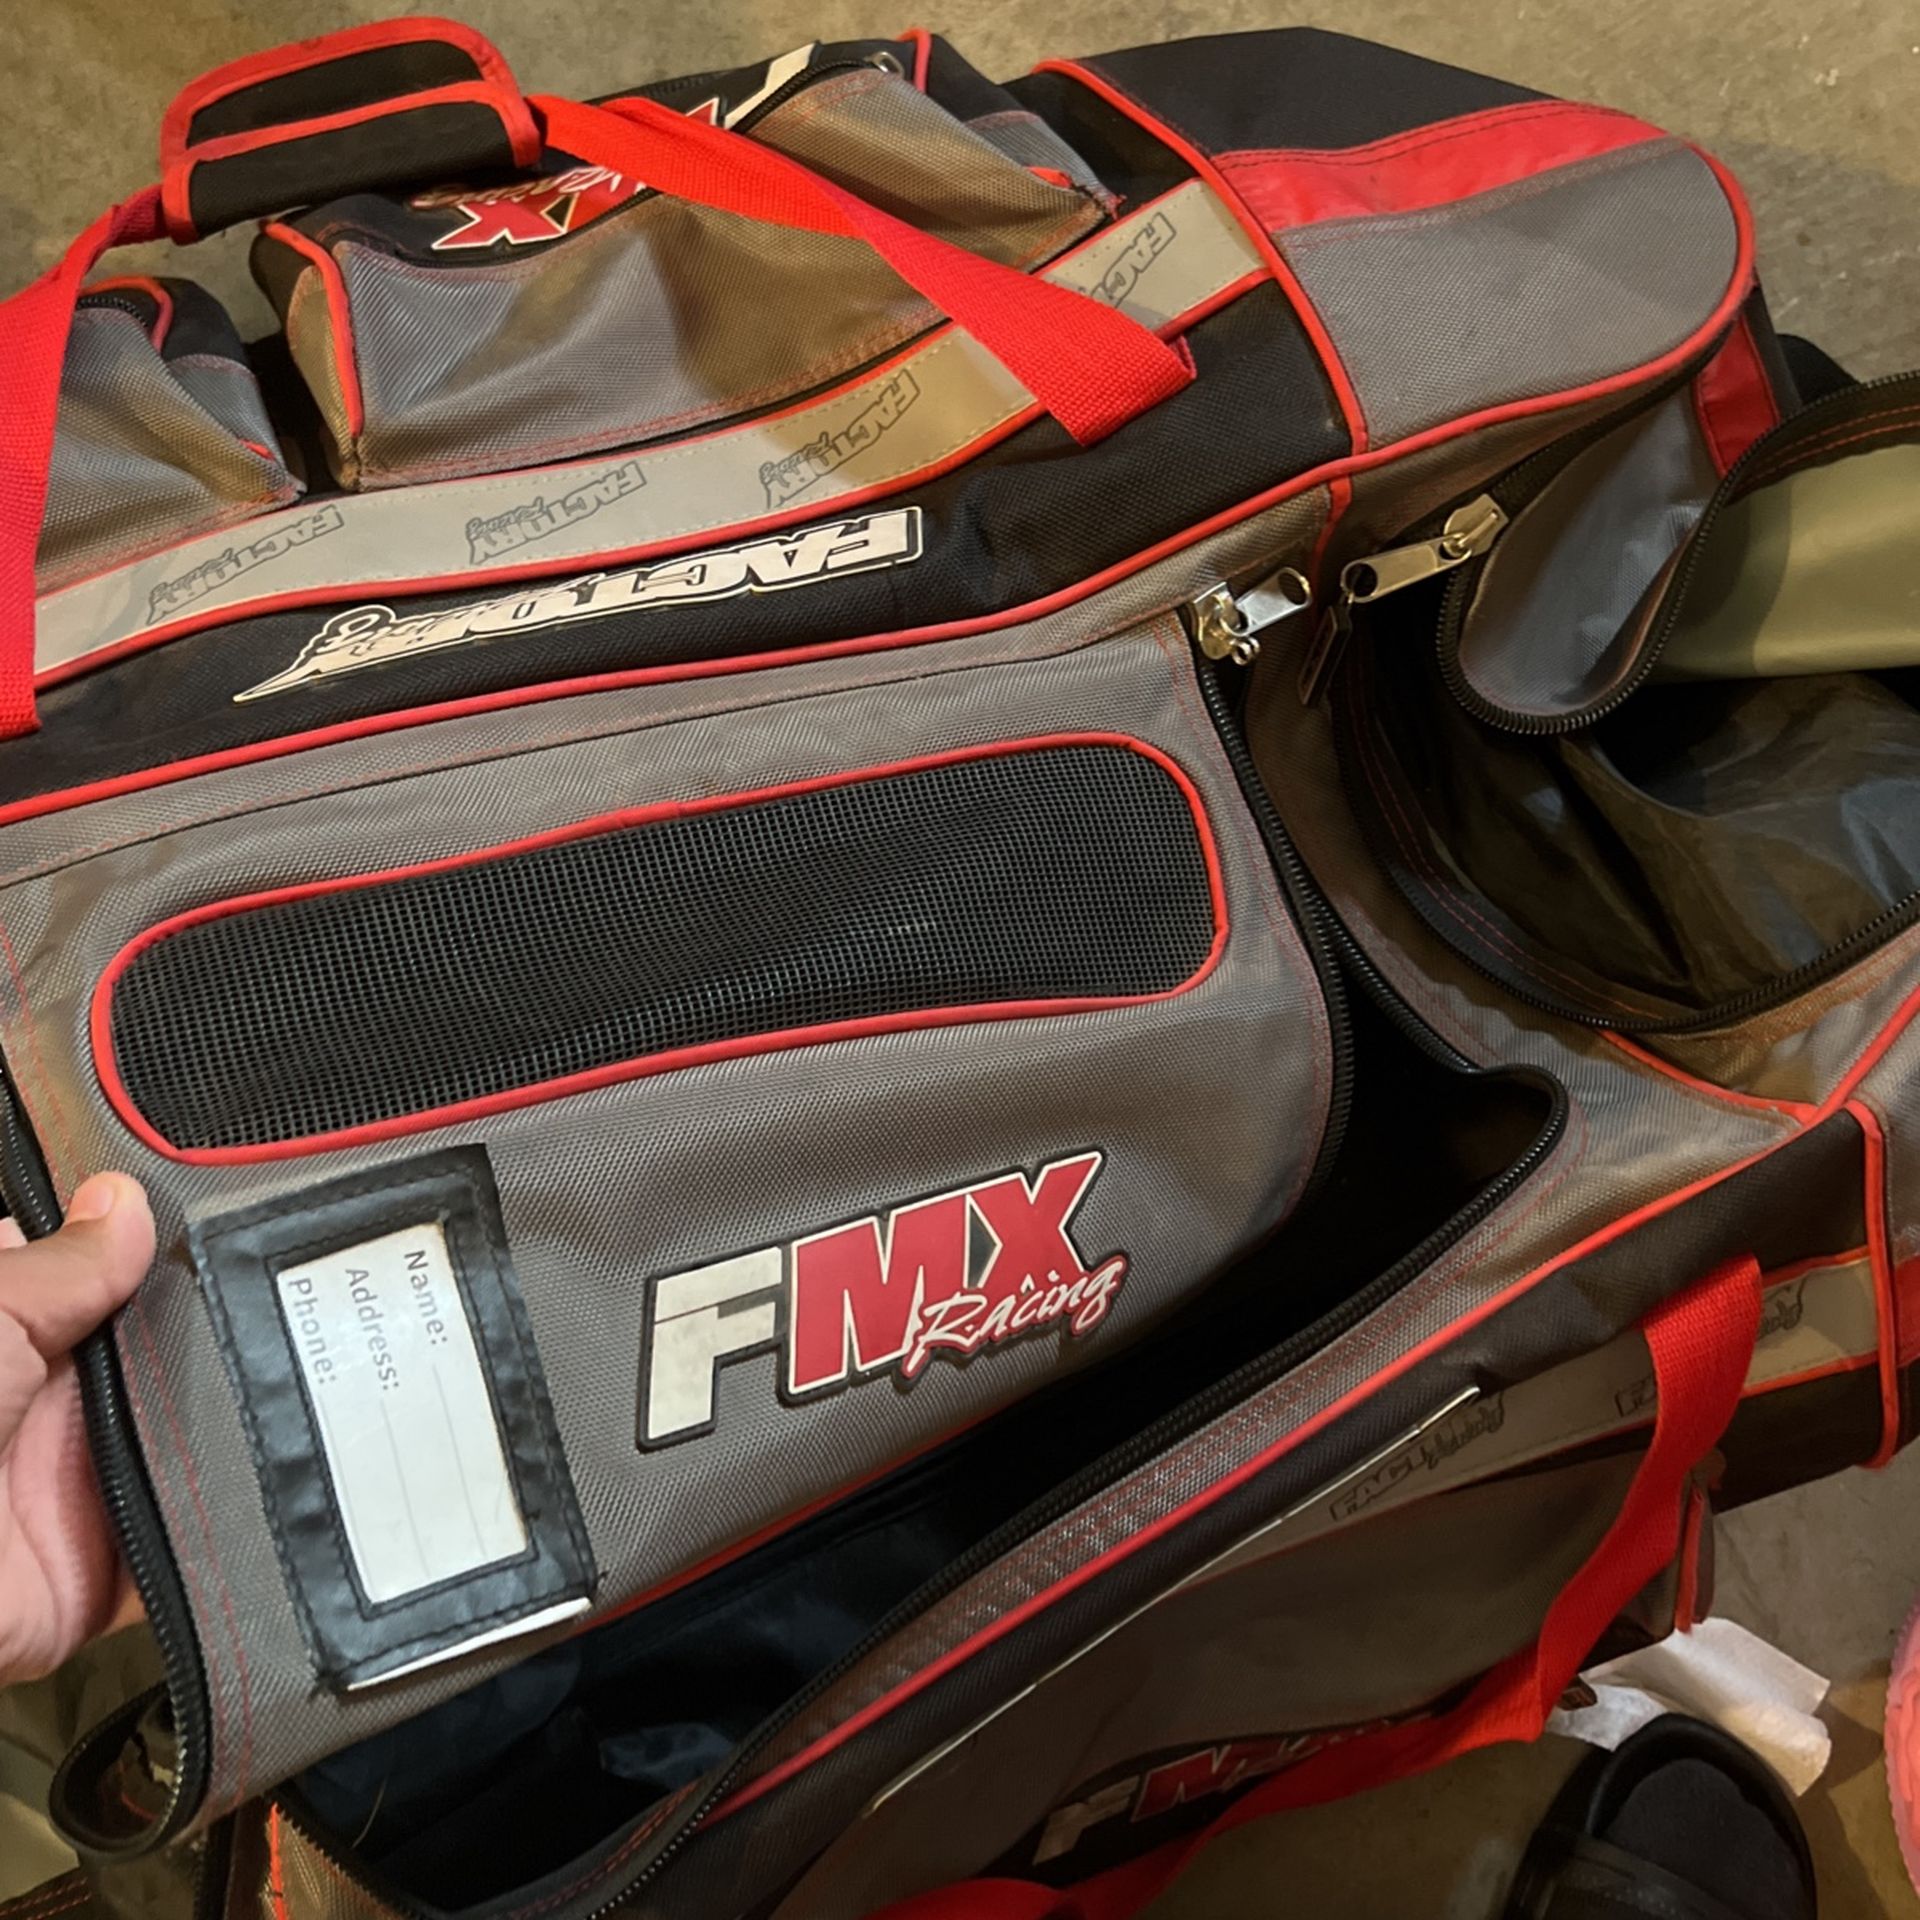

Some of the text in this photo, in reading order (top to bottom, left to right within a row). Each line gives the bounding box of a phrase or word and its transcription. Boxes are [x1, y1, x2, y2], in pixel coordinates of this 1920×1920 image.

[764, 368, 921, 509] FACTORY
[147, 505, 343, 626] FACTORY
[470, 461, 646, 566] FACTORY
[235, 507, 922, 702] FACTORY
[288, 1277, 336, 1385] Phone:
[345, 1267, 400, 1392] Address:
[403, 1249, 448, 1346] Name:
[643, 1150, 1103, 1444] FMX
[902, 1254, 1128, 1379] Racing
